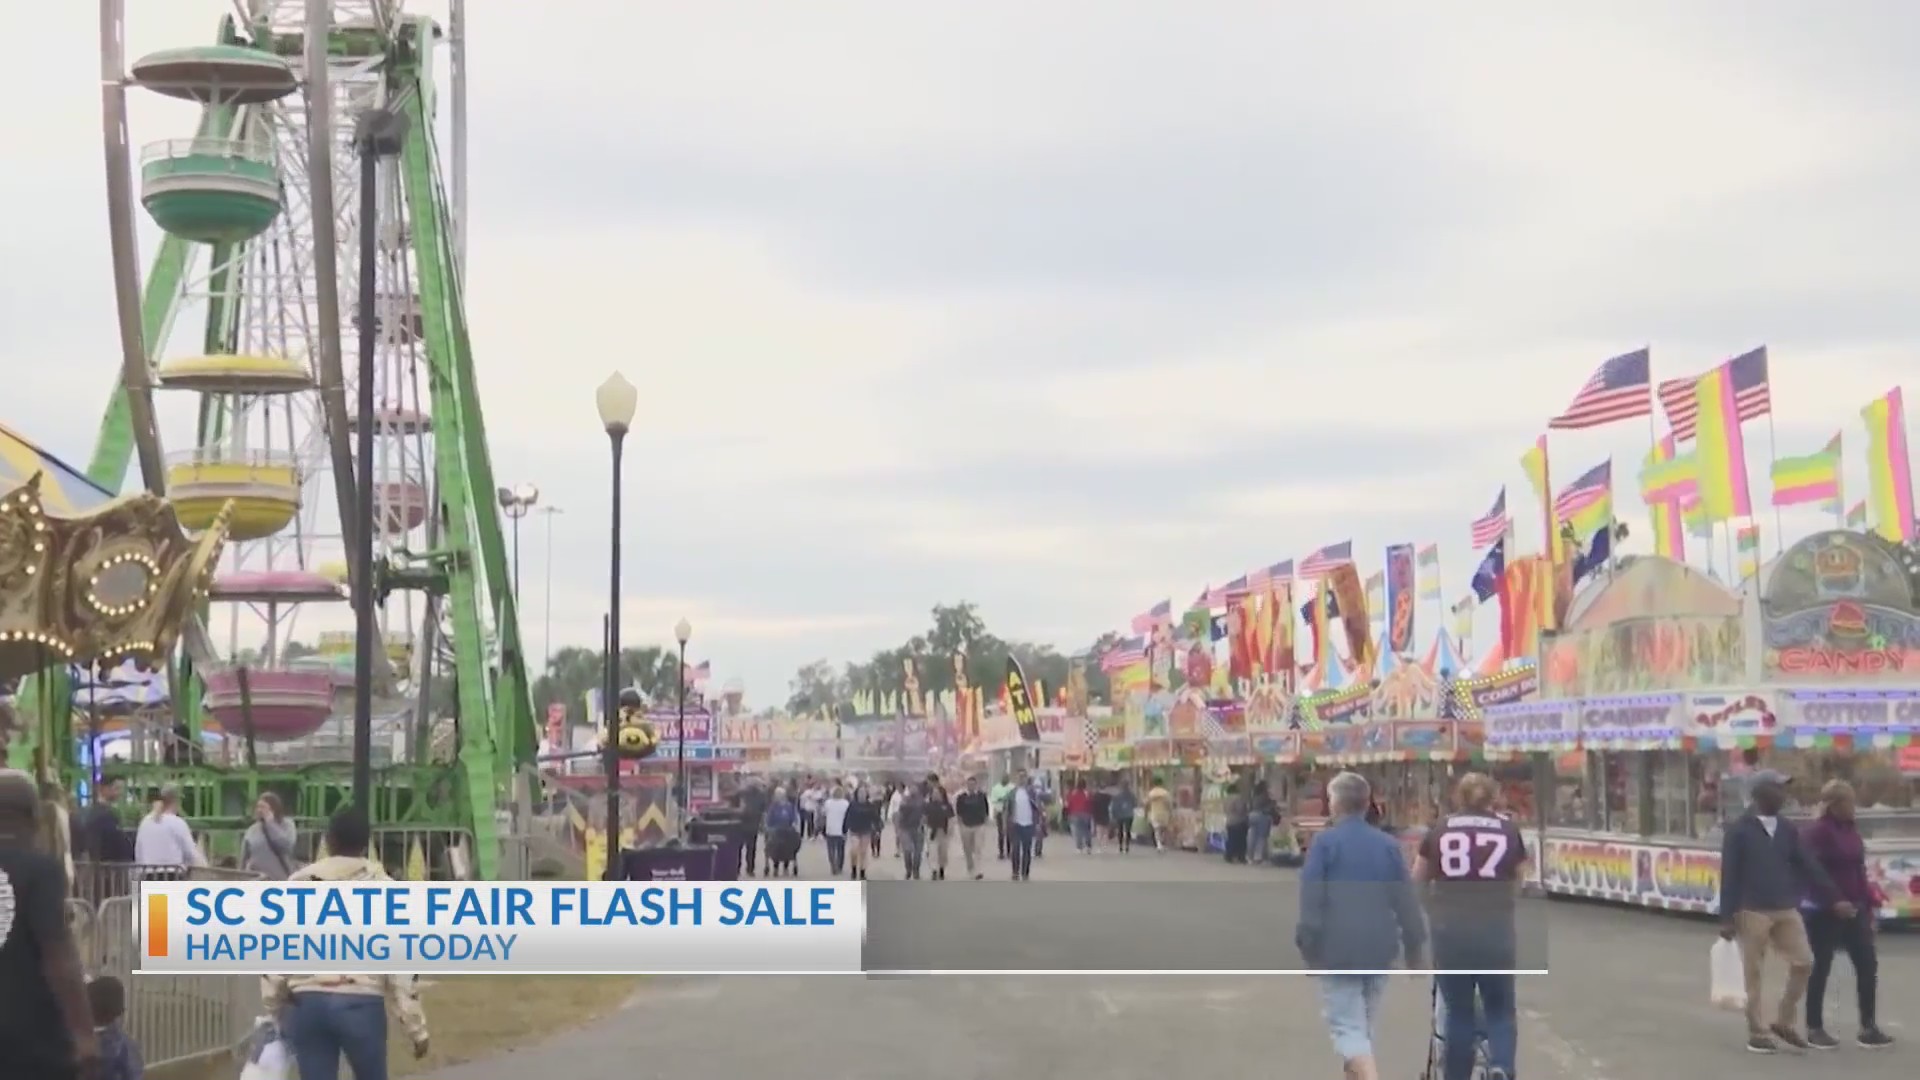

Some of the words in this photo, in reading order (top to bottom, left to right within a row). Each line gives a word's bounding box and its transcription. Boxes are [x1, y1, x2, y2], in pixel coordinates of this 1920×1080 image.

[1780, 647, 1906, 673] CANDY
[1008, 671, 1034, 725] ATM
[1478, 684, 1518, 704] CORN
[1439, 832, 1507, 878] 87
